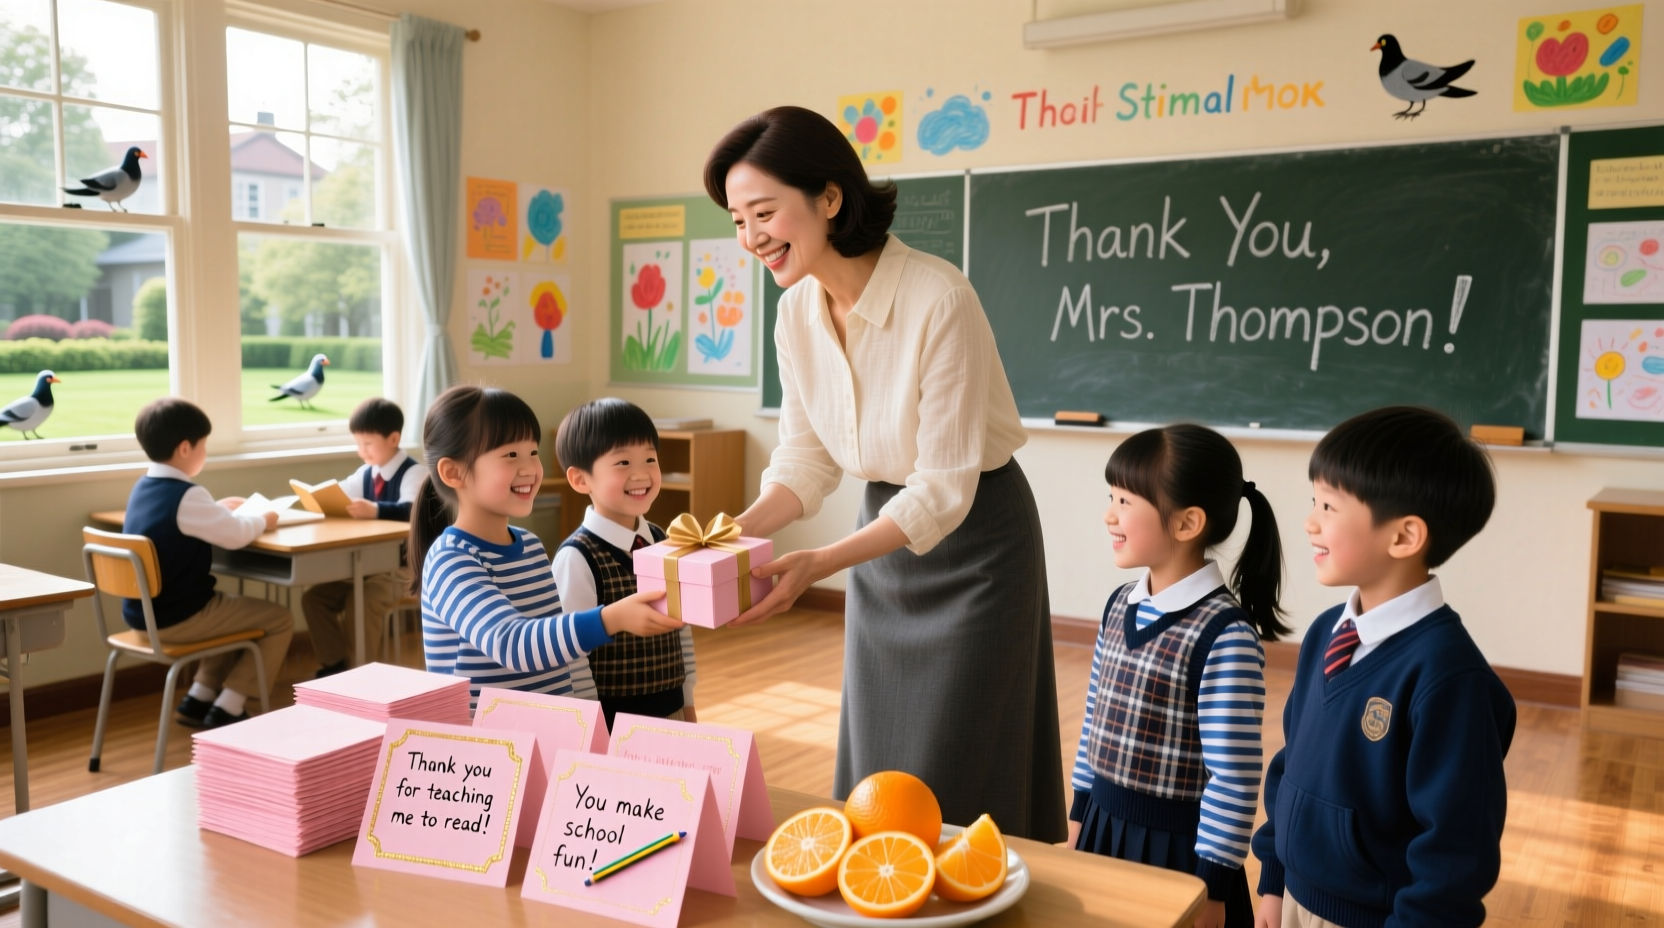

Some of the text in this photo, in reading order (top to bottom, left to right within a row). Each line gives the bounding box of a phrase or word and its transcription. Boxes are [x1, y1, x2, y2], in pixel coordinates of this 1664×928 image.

[1115, 74, 1234, 121] Stimal
[1025, 191, 1331, 270] Thank You,
[1049, 273, 1473, 372] Mrs. Thompson!
[407, 751, 492, 783] Thank you
[396, 778, 494, 813] for teaching
[575, 784, 665, 821] You make
[390, 810, 491, 835] me to read!
[563, 818, 626, 846] school
[553, 844, 599, 872] fun!
